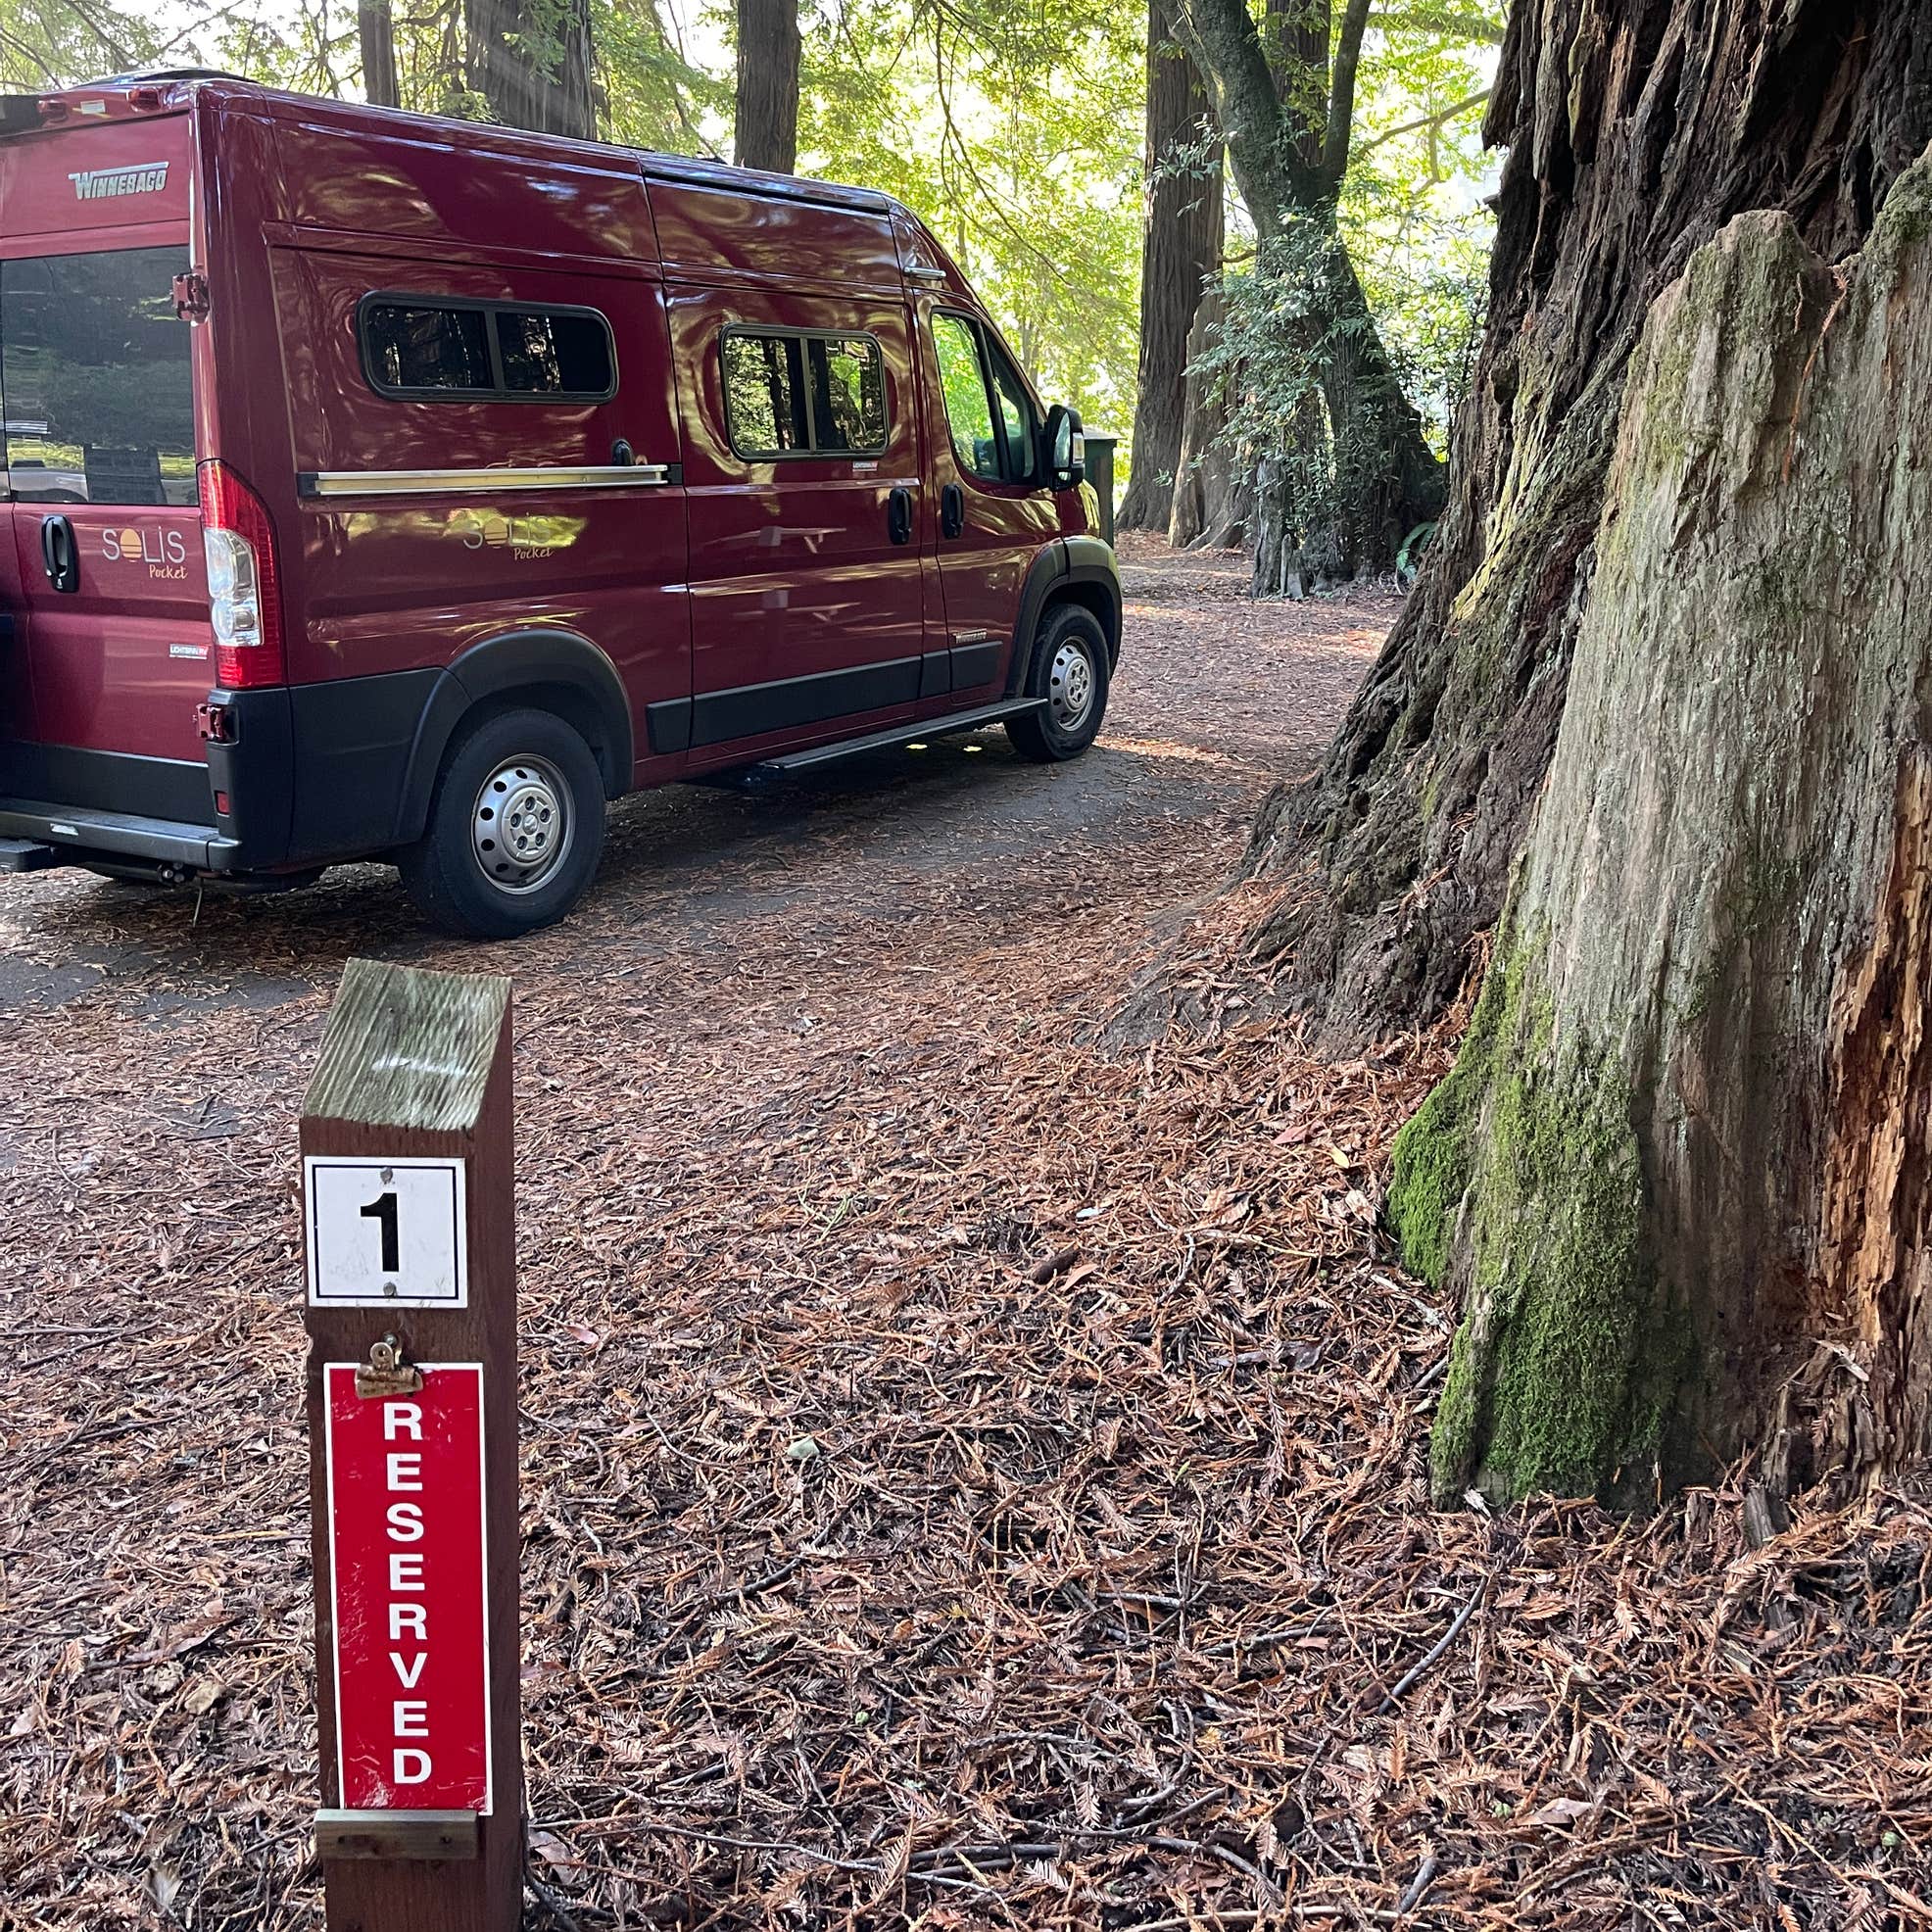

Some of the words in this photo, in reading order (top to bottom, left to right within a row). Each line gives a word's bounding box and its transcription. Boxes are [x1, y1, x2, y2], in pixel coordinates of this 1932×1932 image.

[68, 162, 169, 200] WINNEBAGO
[149, 563, 188, 579] Pocket
[513, 546, 555, 560] Pocket
[360, 1192, 400, 1273] 1
[383, 1402, 432, 1785] RESERVED
